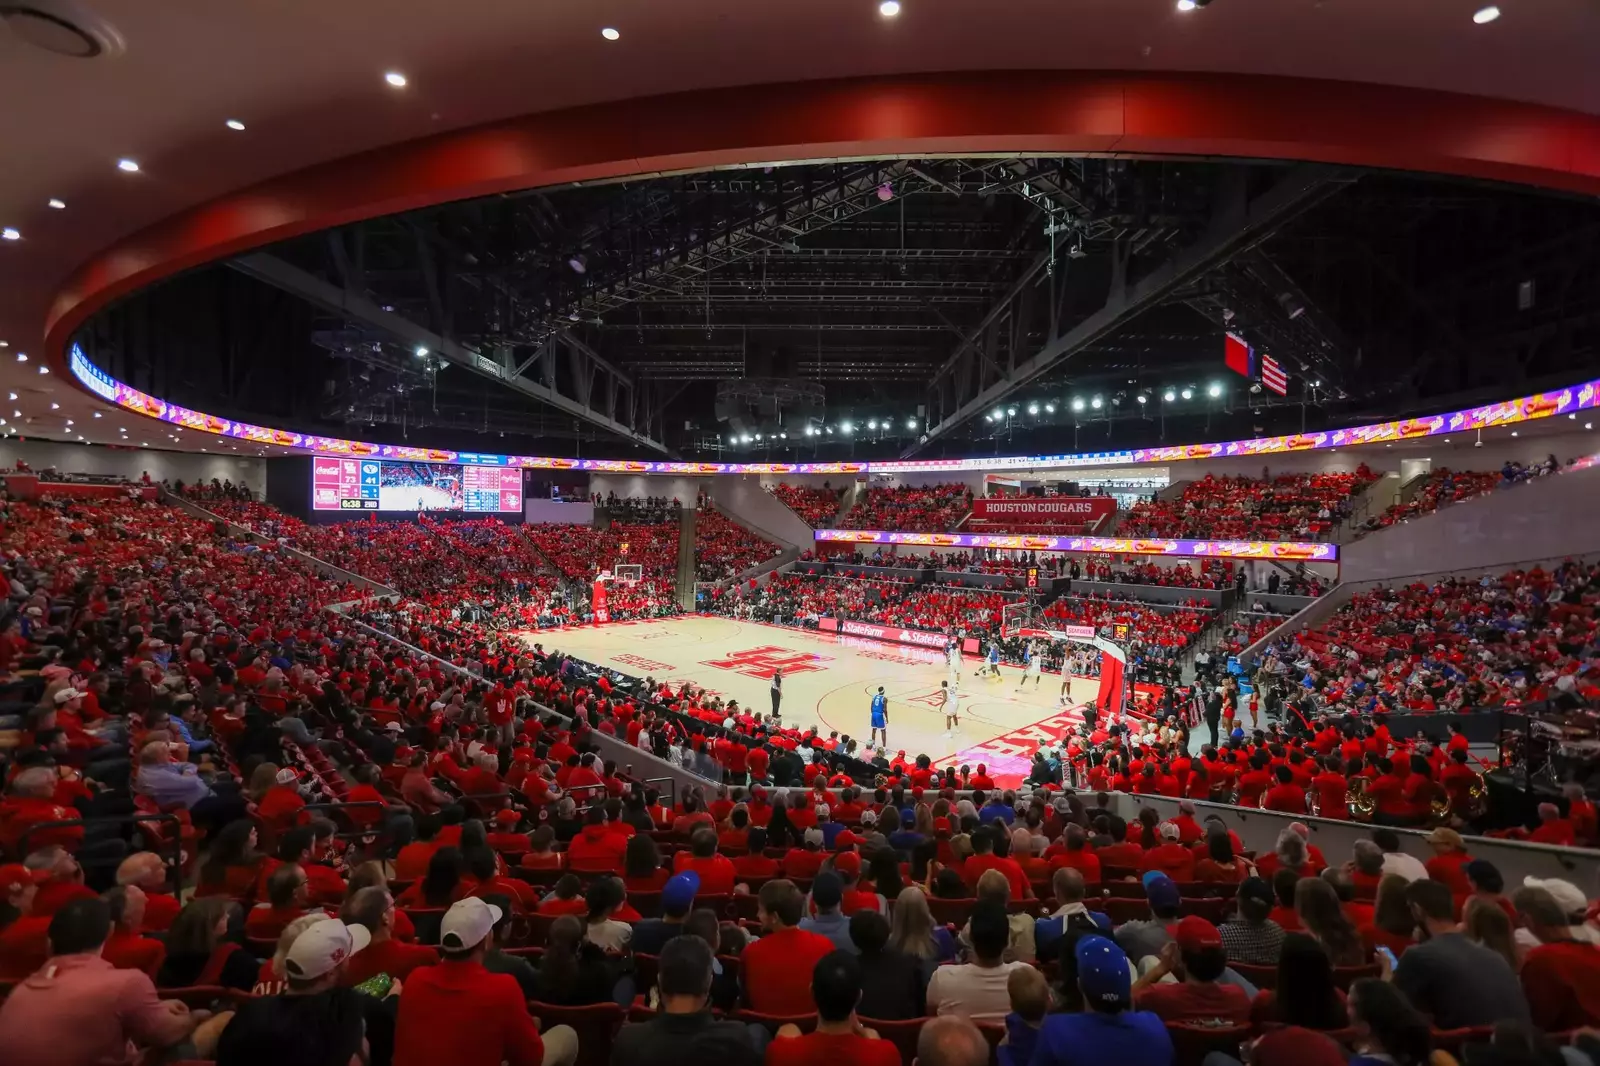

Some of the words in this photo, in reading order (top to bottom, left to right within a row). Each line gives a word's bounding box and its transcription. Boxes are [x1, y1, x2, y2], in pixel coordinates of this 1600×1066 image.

[342, 499, 361, 508] 6:38
[986, 503, 1036, 513] HOUSTON
[1037, 502, 1092, 513] COUGARS
